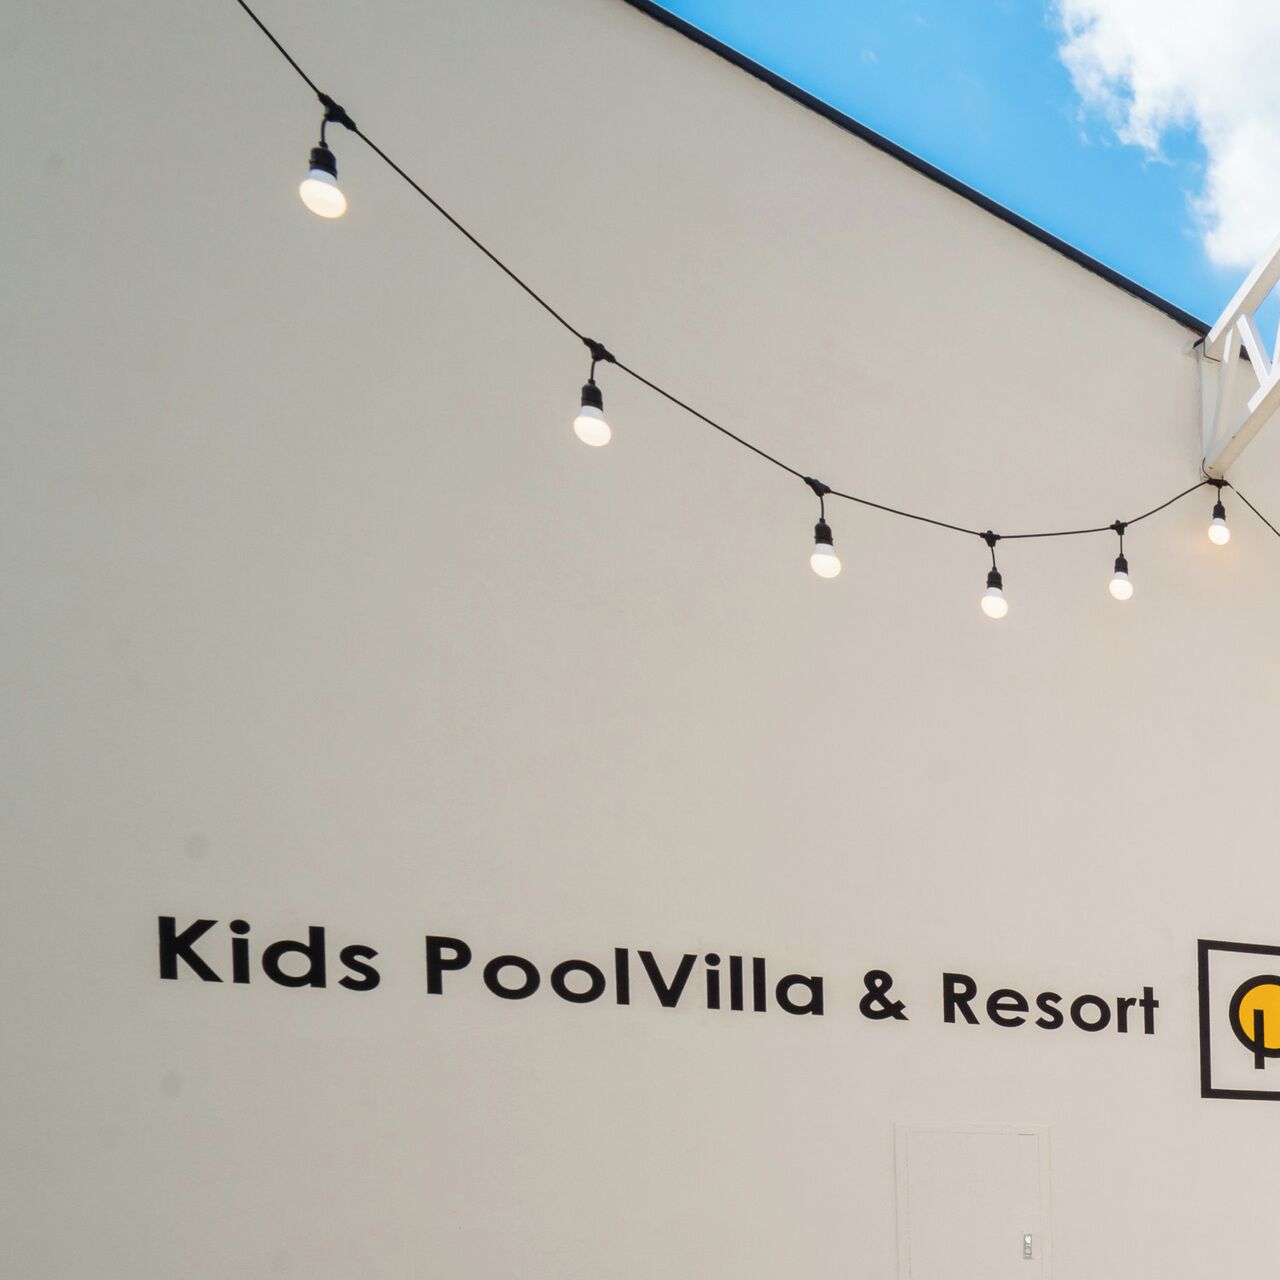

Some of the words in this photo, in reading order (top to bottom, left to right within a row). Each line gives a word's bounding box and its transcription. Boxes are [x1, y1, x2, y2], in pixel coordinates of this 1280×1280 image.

[159, 916, 381, 992] Kids
[426, 936, 824, 1016] PoolVilla
[859, 969, 909, 1021] &
[942, 973, 1159, 1035] Resort
